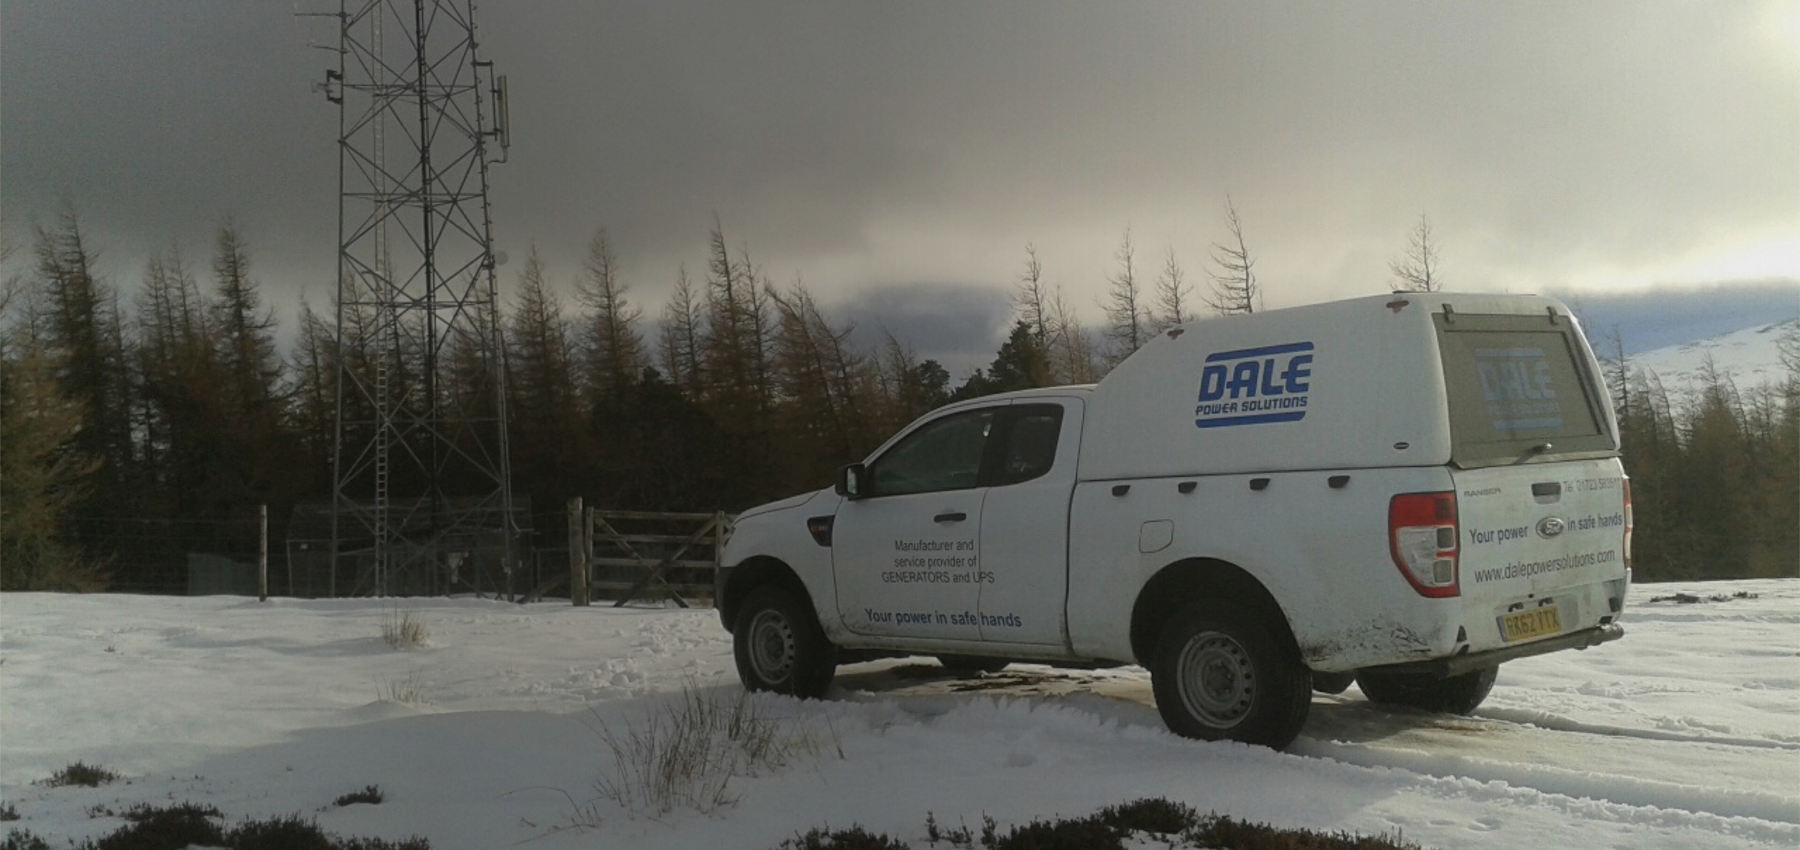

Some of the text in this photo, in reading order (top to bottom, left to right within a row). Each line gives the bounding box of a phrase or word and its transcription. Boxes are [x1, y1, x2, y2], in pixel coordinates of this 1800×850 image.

[1198, 354, 1313, 402] DALE
[1195, 396, 1308, 416] POWER SOLUTIONS
[1469, 512, 1623, 545] Your power in safe hands
[895, 539, 974, 551] Manufacturer and
[894, 555, 977, 569] service provider of
[1474, 549, 1615, 583] www.dalepowersolutions.com
[881, 572, 995, 584] GENERATORS and UPS
[864, 608, 1022, 627] Your power in safe hands
